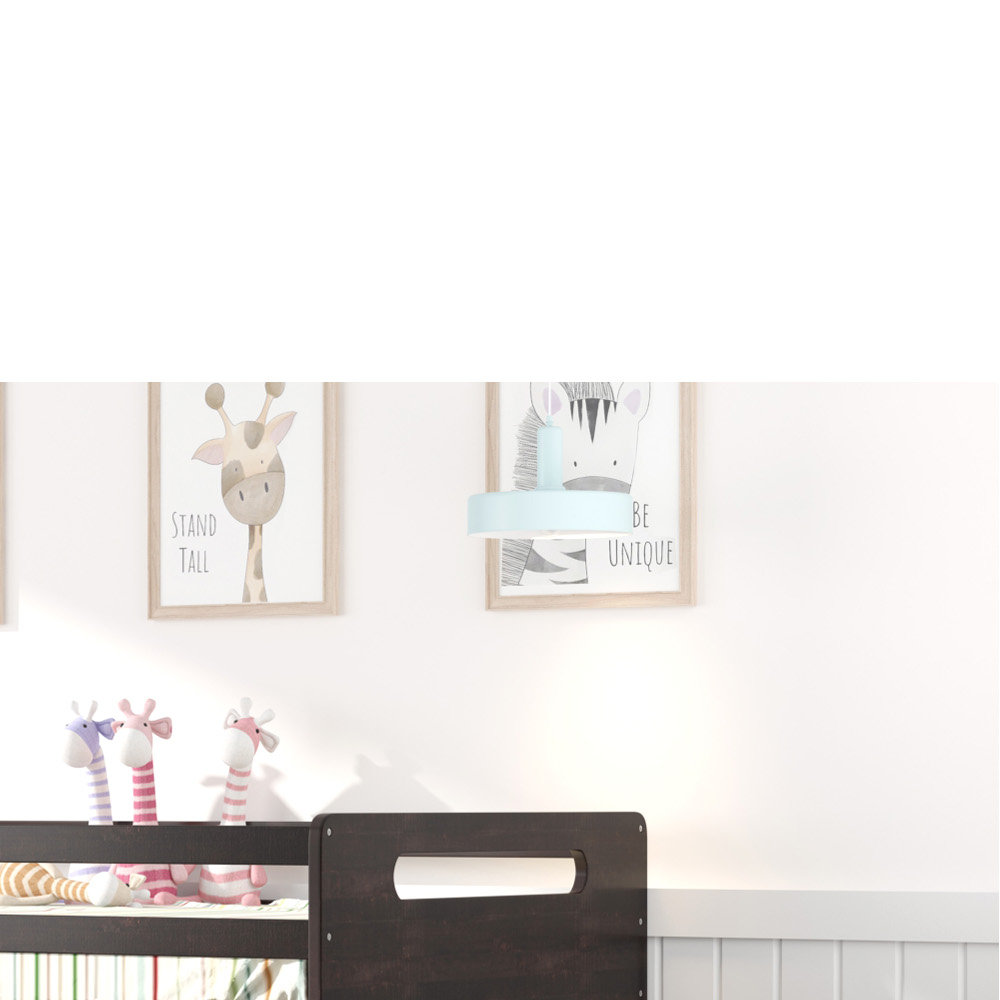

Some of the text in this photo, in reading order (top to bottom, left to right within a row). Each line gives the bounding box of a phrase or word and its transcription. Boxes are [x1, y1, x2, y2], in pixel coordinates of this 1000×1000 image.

[171, 511, 217, 539] STAND
[632, 501, 649, 528] BE
[179, 547, 209, 573] TALL
[608, 538, 673, 572] UNIQUE
